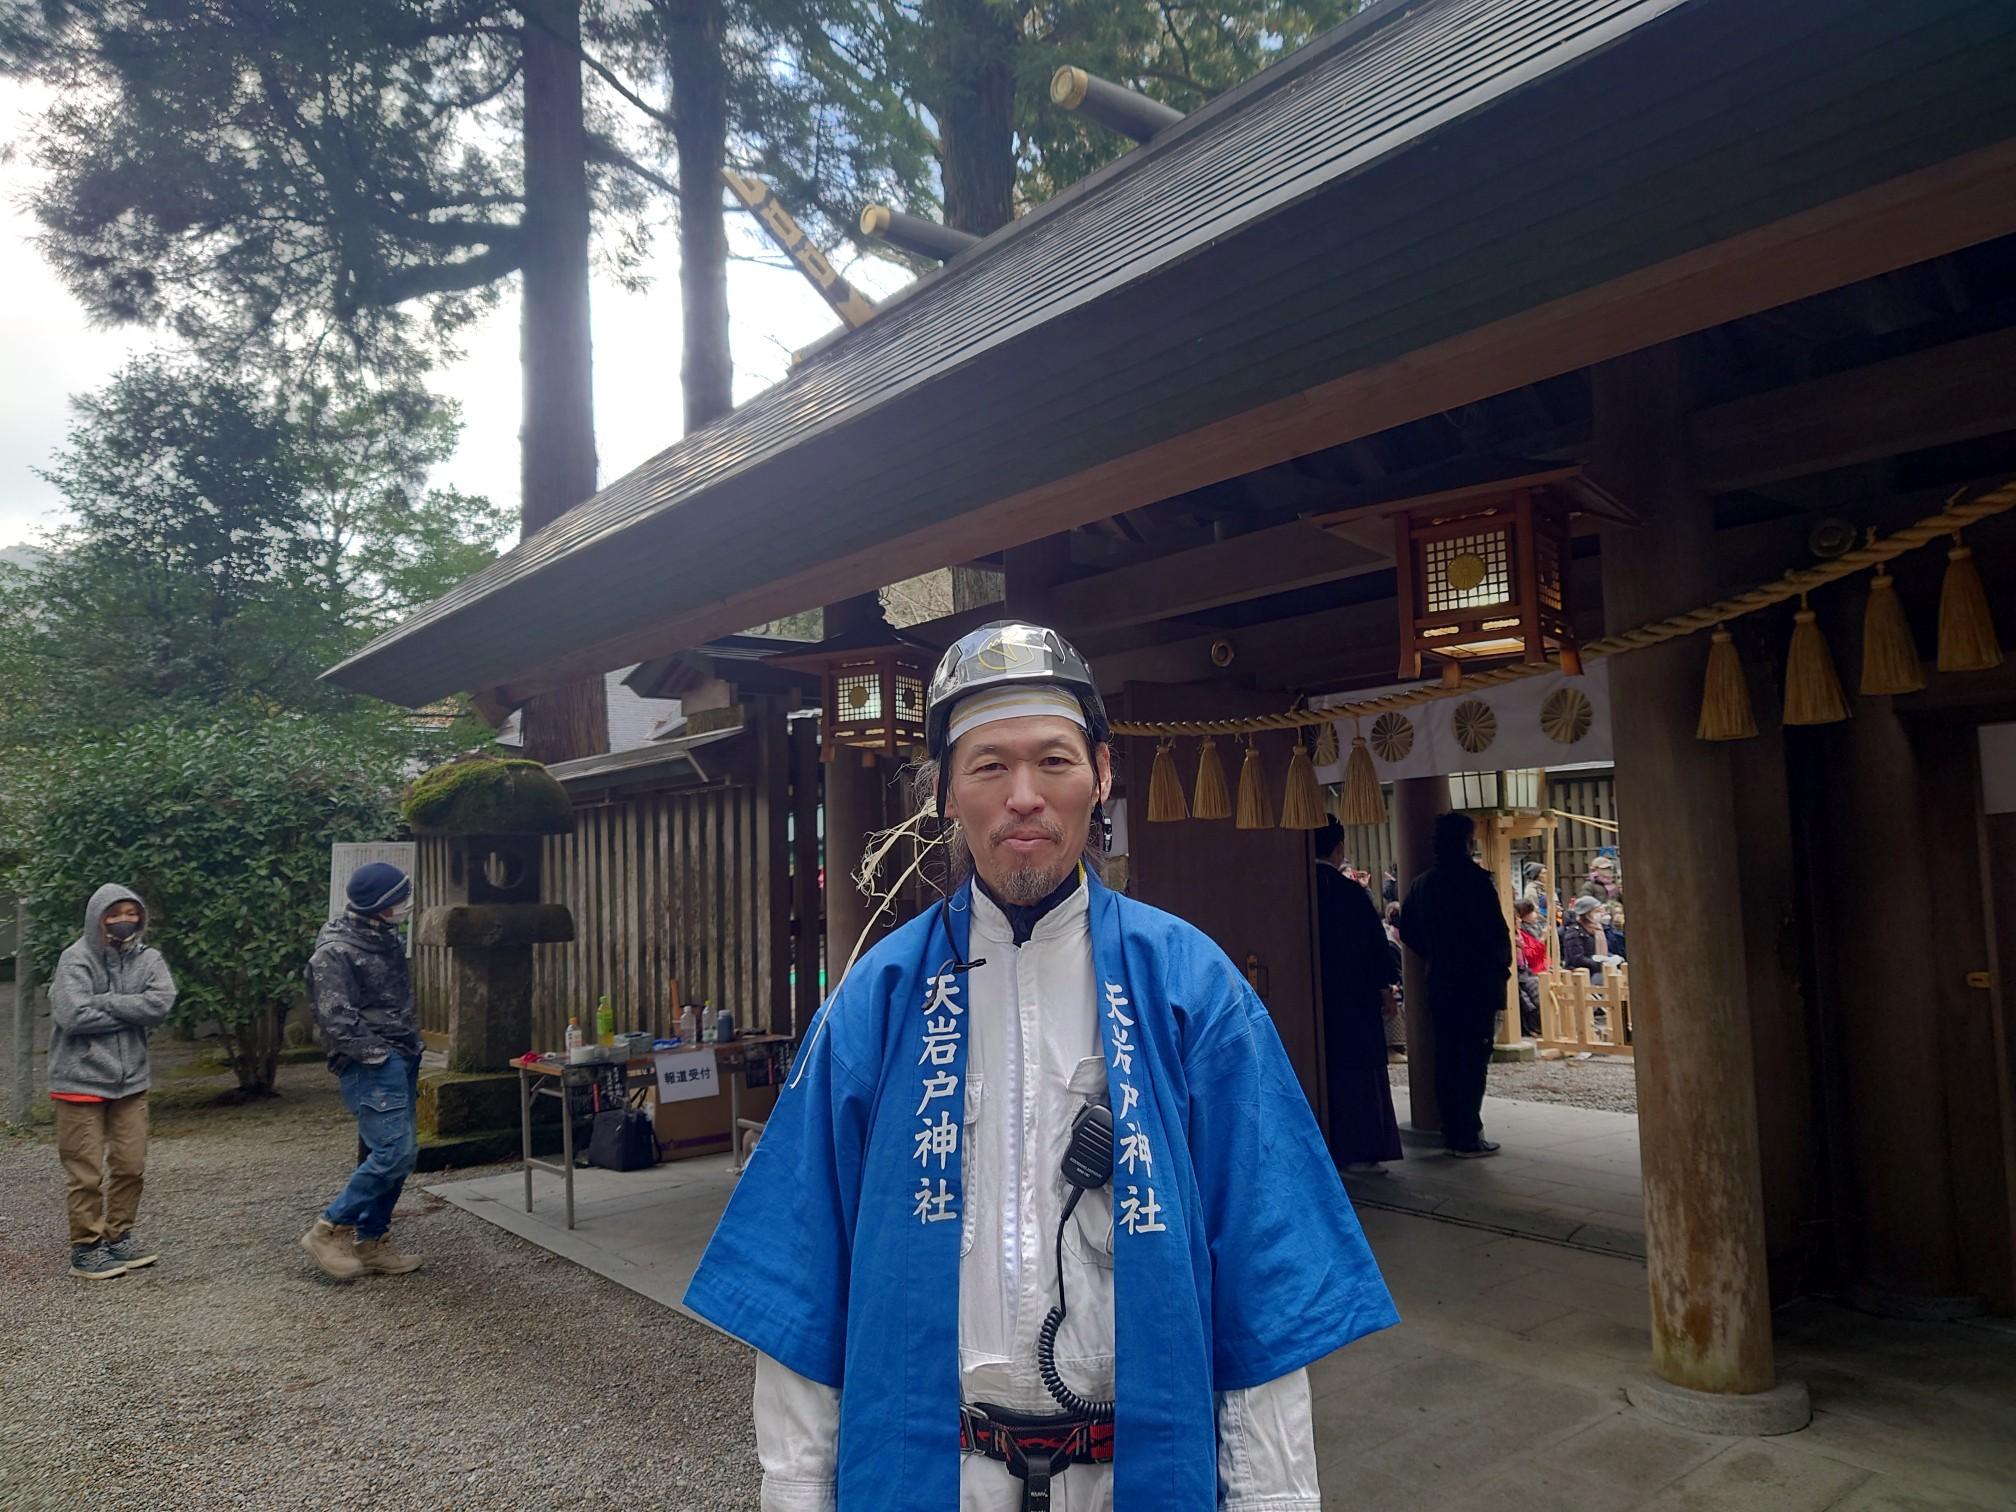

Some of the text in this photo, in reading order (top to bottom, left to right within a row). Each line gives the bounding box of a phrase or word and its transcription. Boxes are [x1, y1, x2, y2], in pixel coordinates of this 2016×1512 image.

[664, 1067, 711, 1084] 報道受付
[913, 974, 964, 1225] 天岩戸神社
